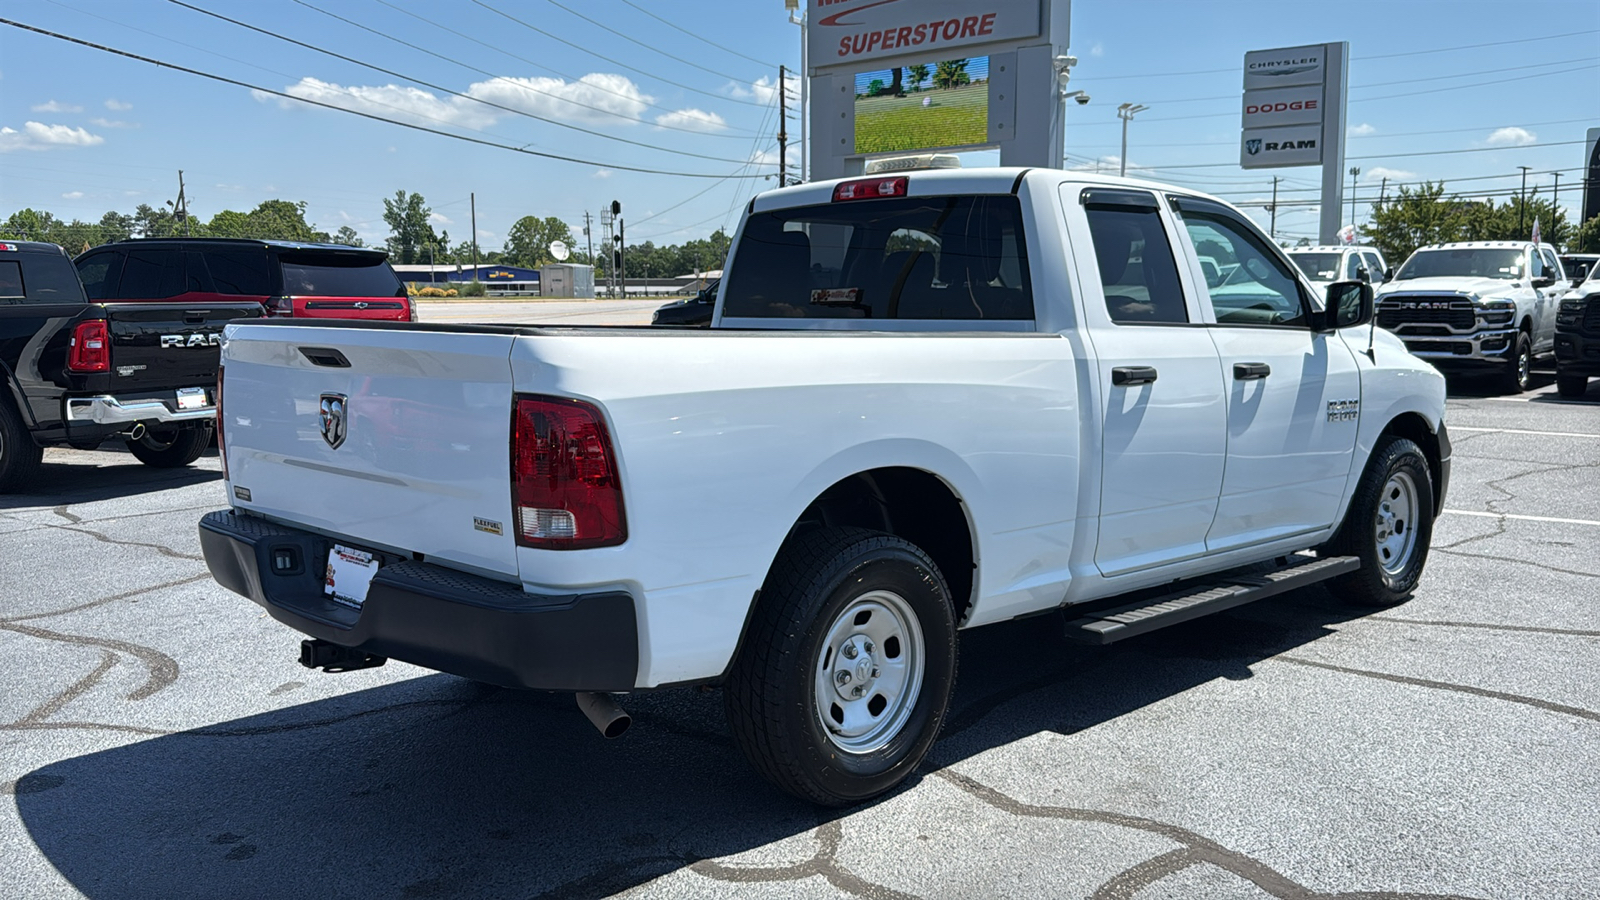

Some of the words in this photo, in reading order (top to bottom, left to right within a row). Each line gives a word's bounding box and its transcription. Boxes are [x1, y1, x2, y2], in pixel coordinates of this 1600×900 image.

[838, 13, 997, 57] SUPERSTORE
[1249, 57, 1318, 69] CHRYSLER
[1246, 100, 1318, 114] DODGE
[1265, 139, 1316, 151] RAM
[1401, 302, 1449, 310] RAM
[1327, 399, 1359, 410] RAM
